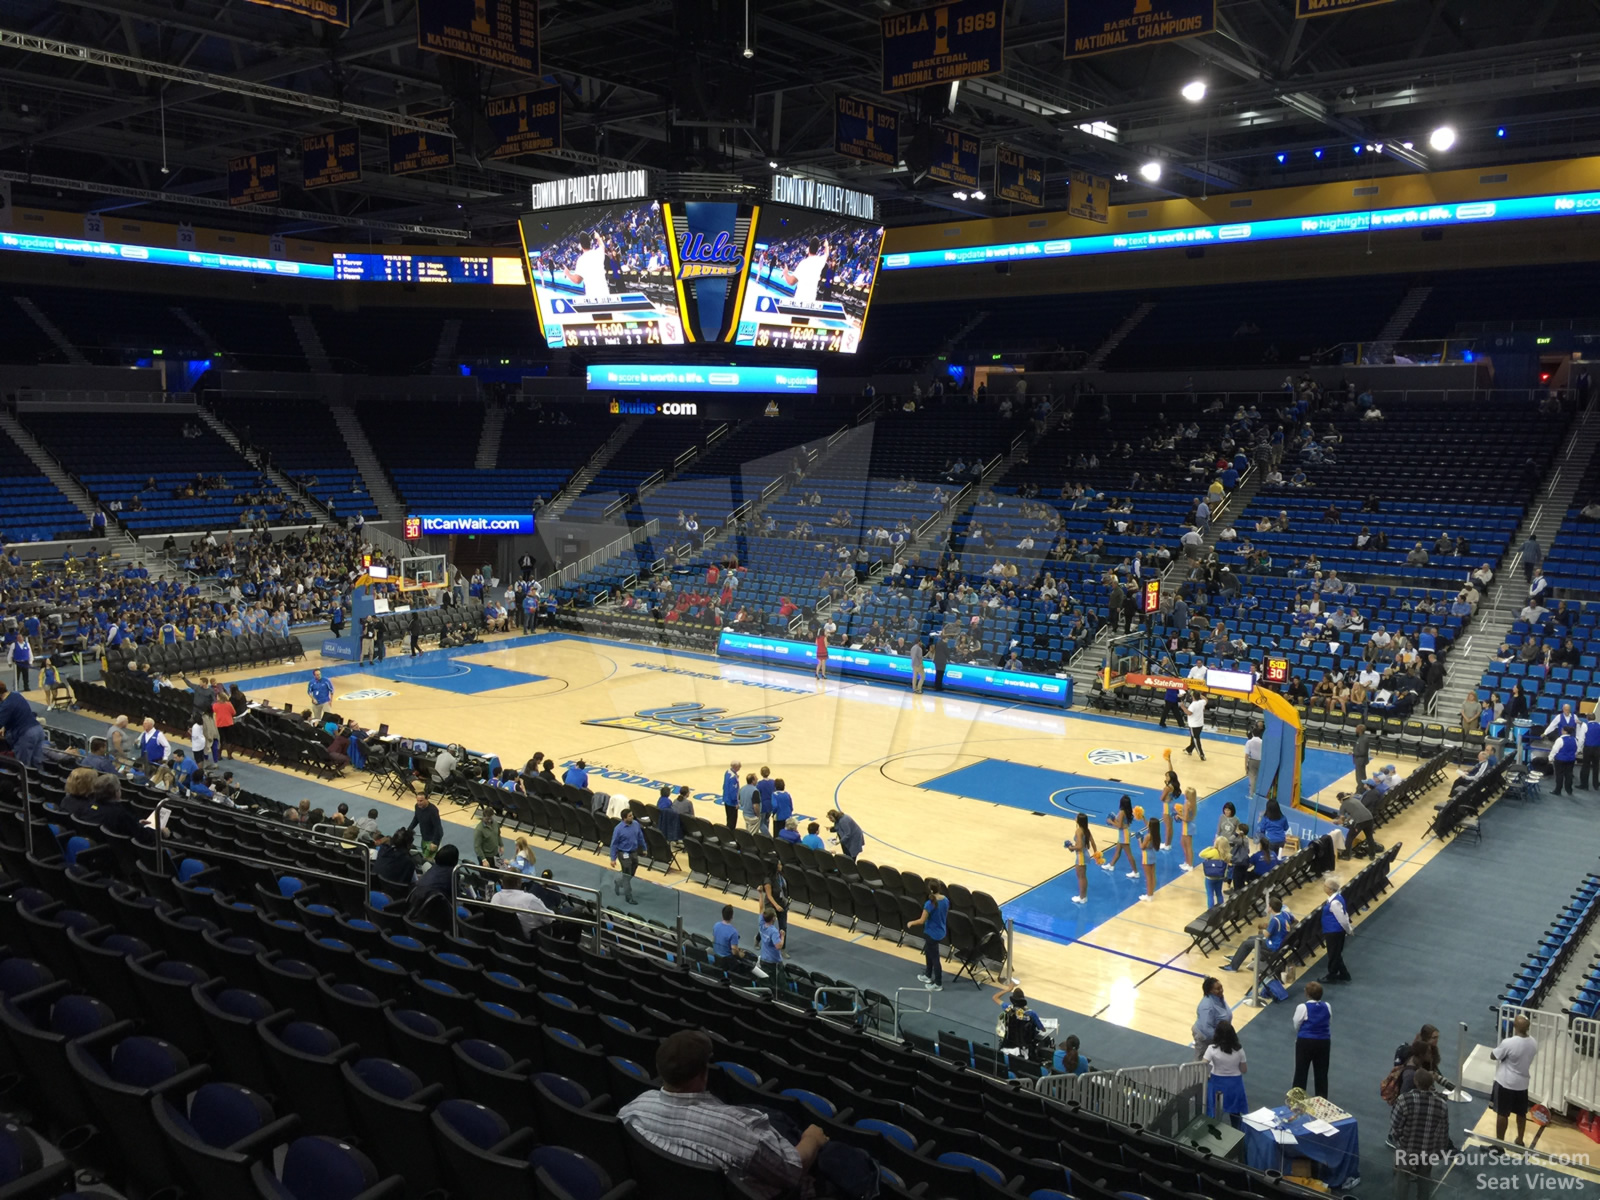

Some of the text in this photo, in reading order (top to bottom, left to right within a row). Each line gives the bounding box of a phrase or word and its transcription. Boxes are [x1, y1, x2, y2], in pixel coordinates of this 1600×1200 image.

[884, 12, 929, 38] UCLA
[957, 11, 996, 35] 1969
[1104, 10, 1173, 32] BASKETBALL
[1074, 15, 1203, 51] NATIONAL CHAMPIONS
[469, 31, 517, 52] VOLLEYBALL
[427, 32, 533, 70] NATIONAL CHAMPIONS
[912, 52, 968, 69] BASKETBALL
[892, 59, 990, 87] NATIONAL CHAMPIONS
[488, 99, 517, 117] UCLA
[531, 101, 556, 118] 1968
[839, 97, 865, 119] UCLA
[877, 113, 896, 130] 1973
[304, 136, 325, 151] UCLA
[495, 143, 520, 155] ATIONAL
[532, 169, 646, 209] EDWIN W PAULEY PAVILION
[776, 174, 873, 220] EDWIN W PAULEY PAVILION
[1554, 197, 1575, 210] No
[1301, 219, 1318, 231] No
[1319, 216, 1370, 230] highlight
[1371, 213, 1381, 225] is
[1383, 211, 1418, 224] worth
[1419, 212, 1428, 221] a
[3, 235, 18, 245] No
[20, 238, 54, 250] update
[680, 231, 741, 262] Ucla
[1113, 237, 1128, 247] No
[1129, 236, 1147, 246] text
[1148, 234, 1157, 244] is
[1157, 232, 1186, 243] worth
[188, 253, 201, 263] No
[944, 252, 956, 260] No
[957, 250, 985, 261] update
[681, 264, 737, 278] BRUINS
[596, 323, 623, 337] 15:00
[646, 327, 660, 344] 24
[790, 327, 814, 340] 15:00
[828, 336, 841, 350] 24
[619, 374, 640, 383] score
[649, 372, 678, 383] worth
[407, 526, 418, 537] 30
[423, 517, 520, 530] ItCanWait.com
[1147, 592, 1157, 609] 30
[1270, 669, 1283, 679] 30
[727, 678, 815, 694] COURT
[603, 717, 735, 742] BRUINS
